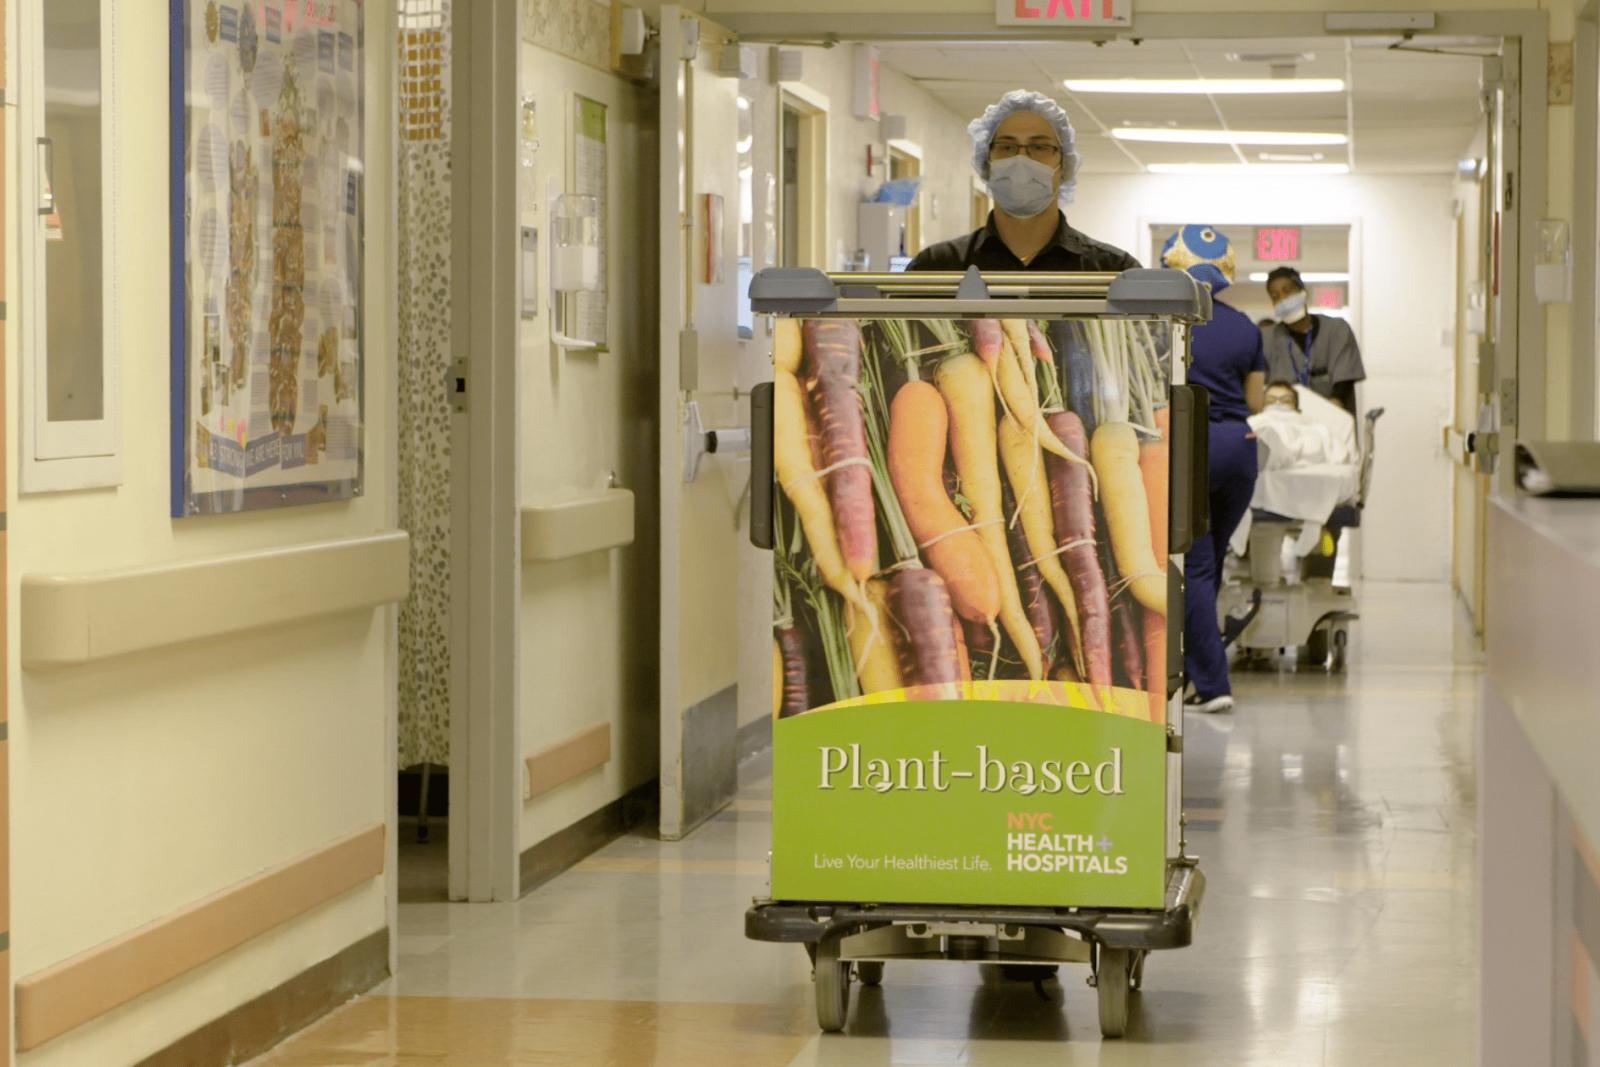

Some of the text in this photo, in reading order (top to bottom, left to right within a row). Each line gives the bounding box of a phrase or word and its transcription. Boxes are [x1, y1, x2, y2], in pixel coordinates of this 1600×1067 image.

[817, 743, 1125, 796] Plant-based
[1007, 812, 1053, 830] NYC
[814, 854, 992, 872] Live Your Healthiest Life.
[1007, 854, 1128, 875] HOSPITALS
